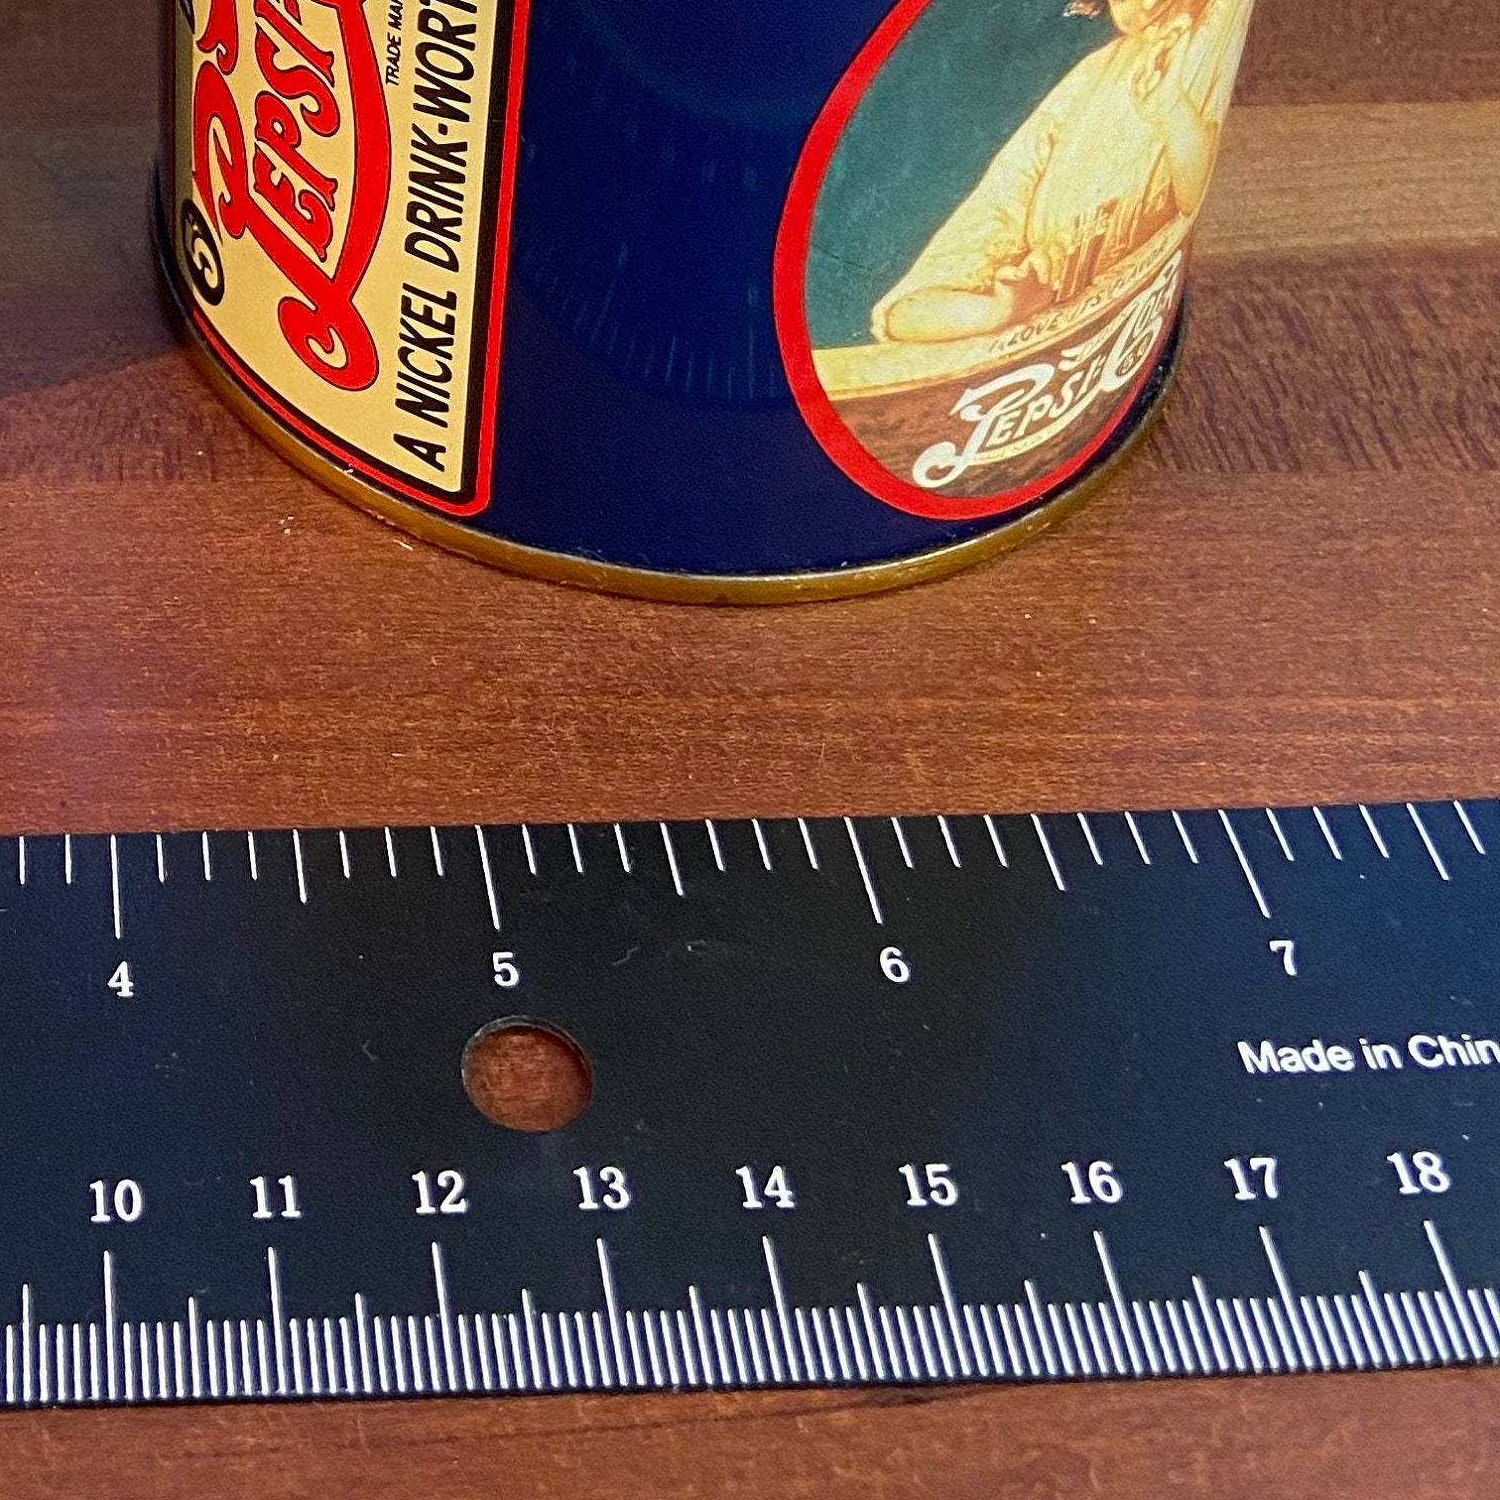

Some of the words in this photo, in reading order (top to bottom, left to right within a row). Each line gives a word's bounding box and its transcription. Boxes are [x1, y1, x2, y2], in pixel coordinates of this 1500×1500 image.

[385, 32, 402, 86] TRADE
[395, 282, 458, 427] NICKEL
[393, 433, 446, 471] A
[107, 960, 135, 998] 4
[492, 951, 520, 987] 5
[879, 946, 910, 983] 6
[1269, 939, 1298, 976] 7
[1237, 1039, 1356, 1075] Made
[1361, 1036, 1404, 1070] in
[89, 1178, 143, 1223] 10
[249, 1174, 301, 1219] 11
[411, 1169, 469, 1215] 12
[572, 1166, 631, 1210] 13
[735, 1165, 795, 1209] 14
[898, 1163, 959, 1207] 15
[1060, 1160, 1124, 1204] 16
[1223, 1157, 1279, 1201] 17
[1386, 1150, 1451, 1195] 18
